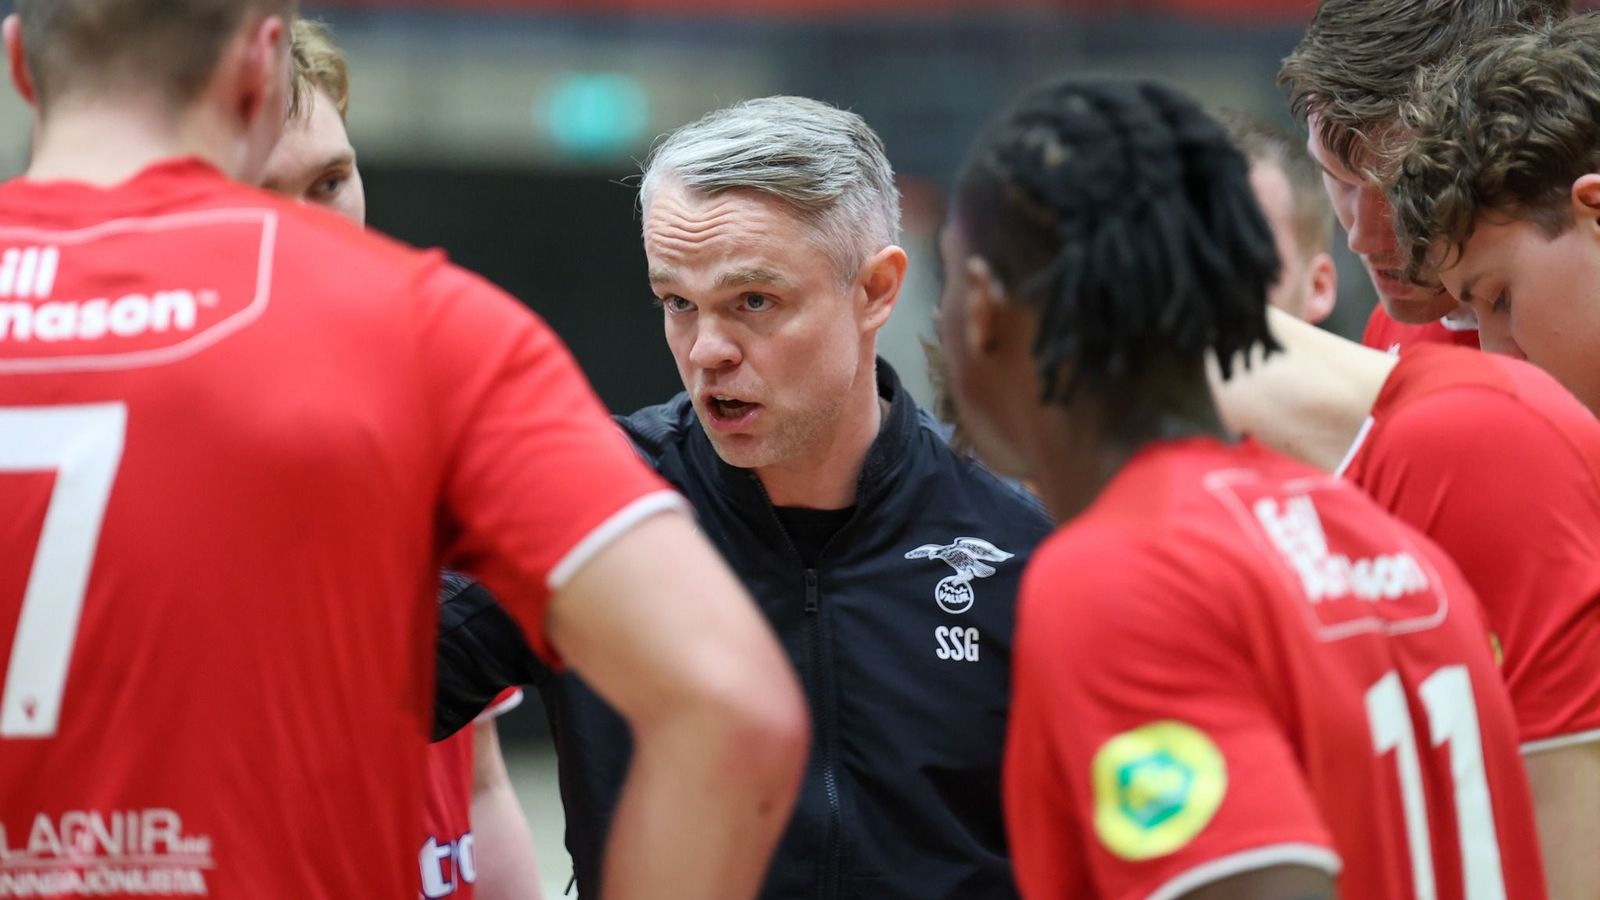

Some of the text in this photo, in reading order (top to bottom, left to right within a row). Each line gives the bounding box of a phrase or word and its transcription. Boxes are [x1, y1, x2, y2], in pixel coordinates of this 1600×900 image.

[0, 401, 128, 738] 7
[935, 625, 980, 662] SSG
[1365, 664, 1506, 900] 11
